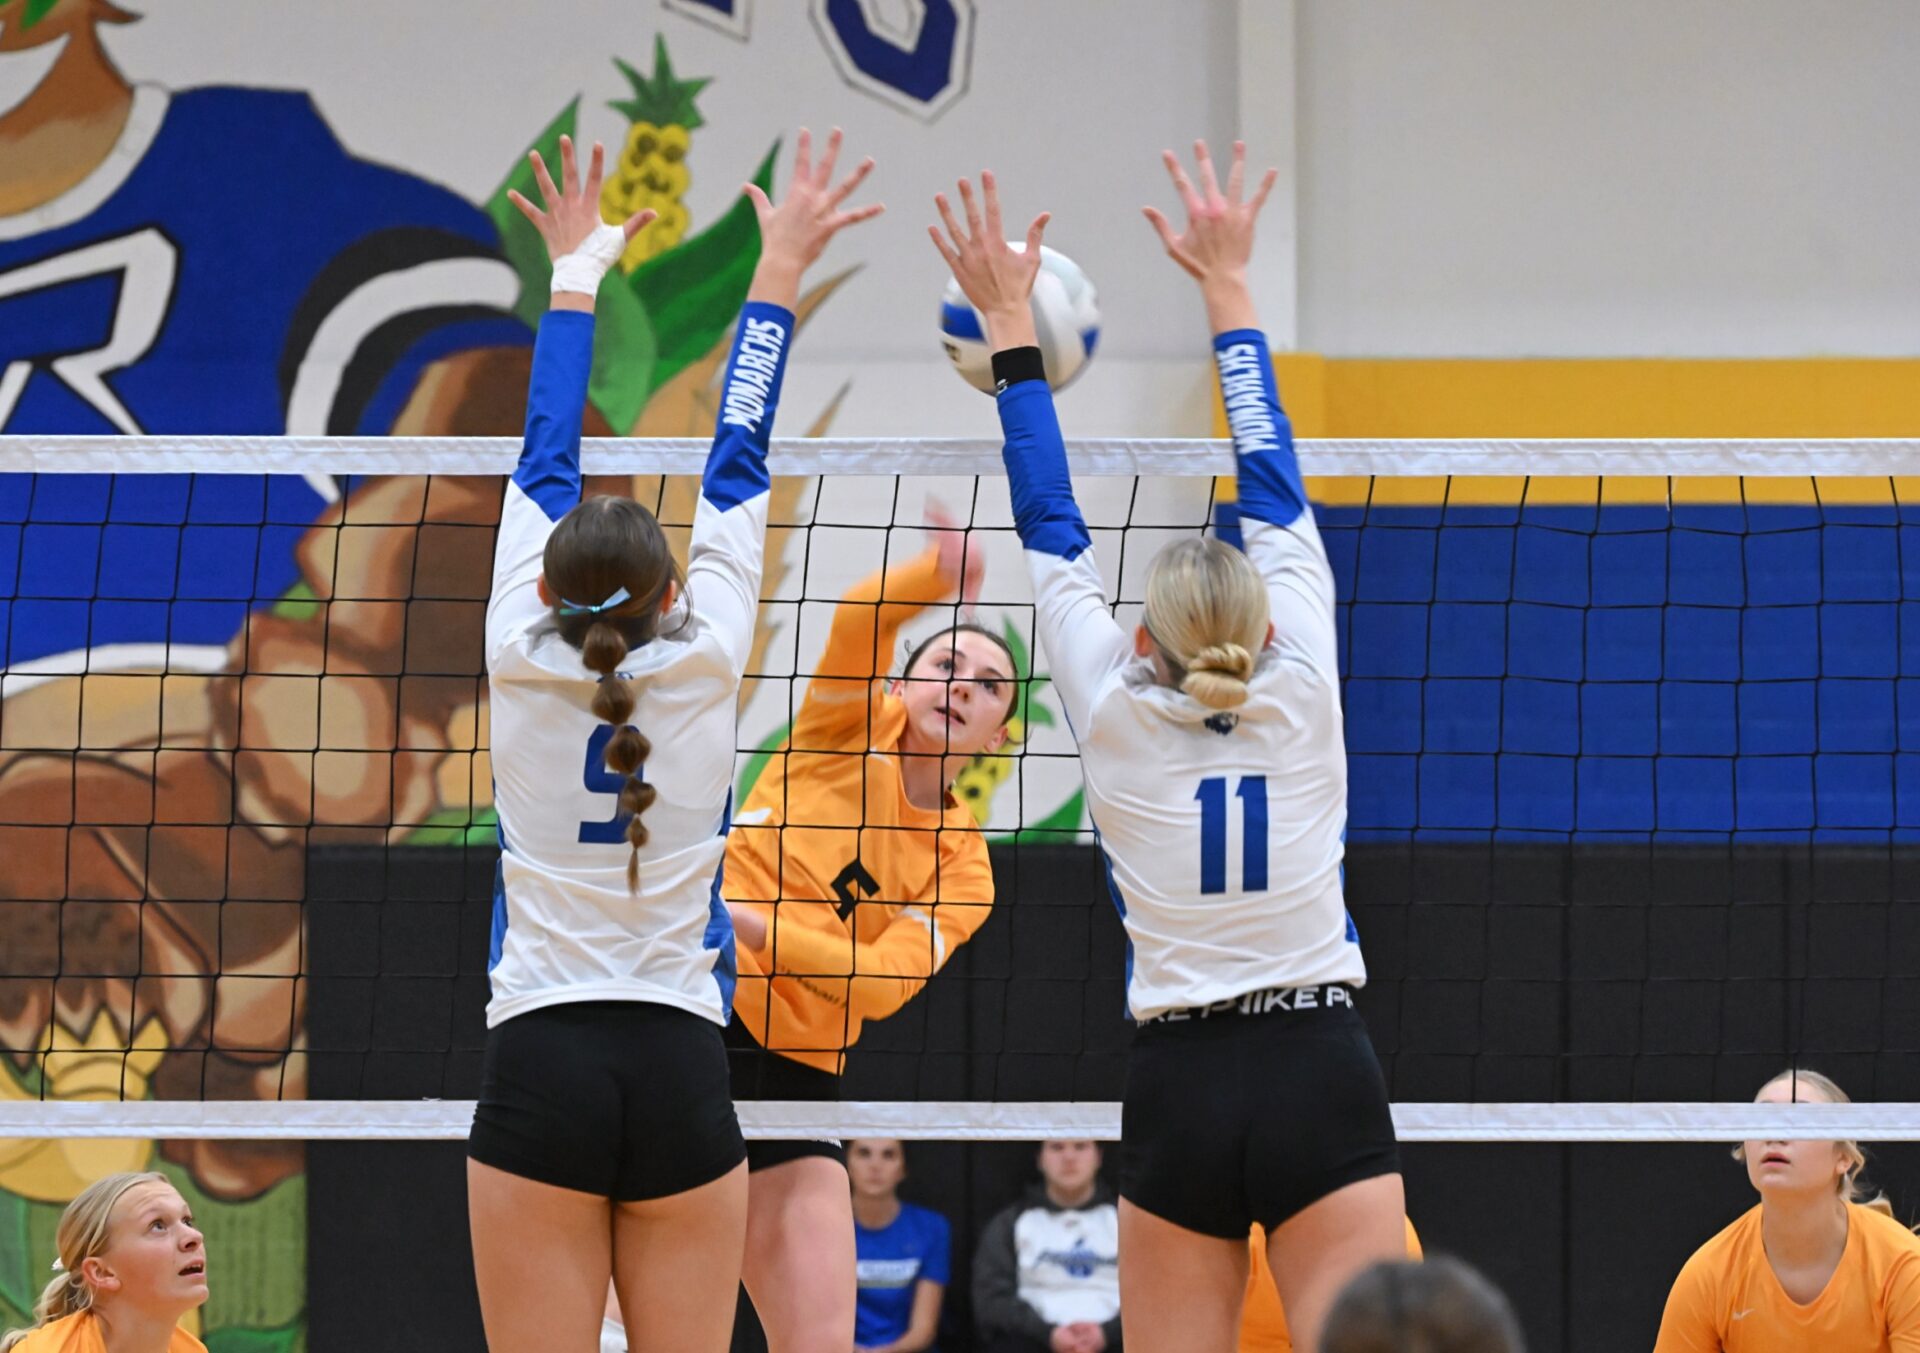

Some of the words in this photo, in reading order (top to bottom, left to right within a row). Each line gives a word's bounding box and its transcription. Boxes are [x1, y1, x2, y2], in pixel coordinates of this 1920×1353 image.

[722, 317, 786, 434] MONARCHS
[1216, 343, 1281, 456] MONARCHS
[578, 724, 644, 844] 9
[1194, 775, 1268, 895] 11
